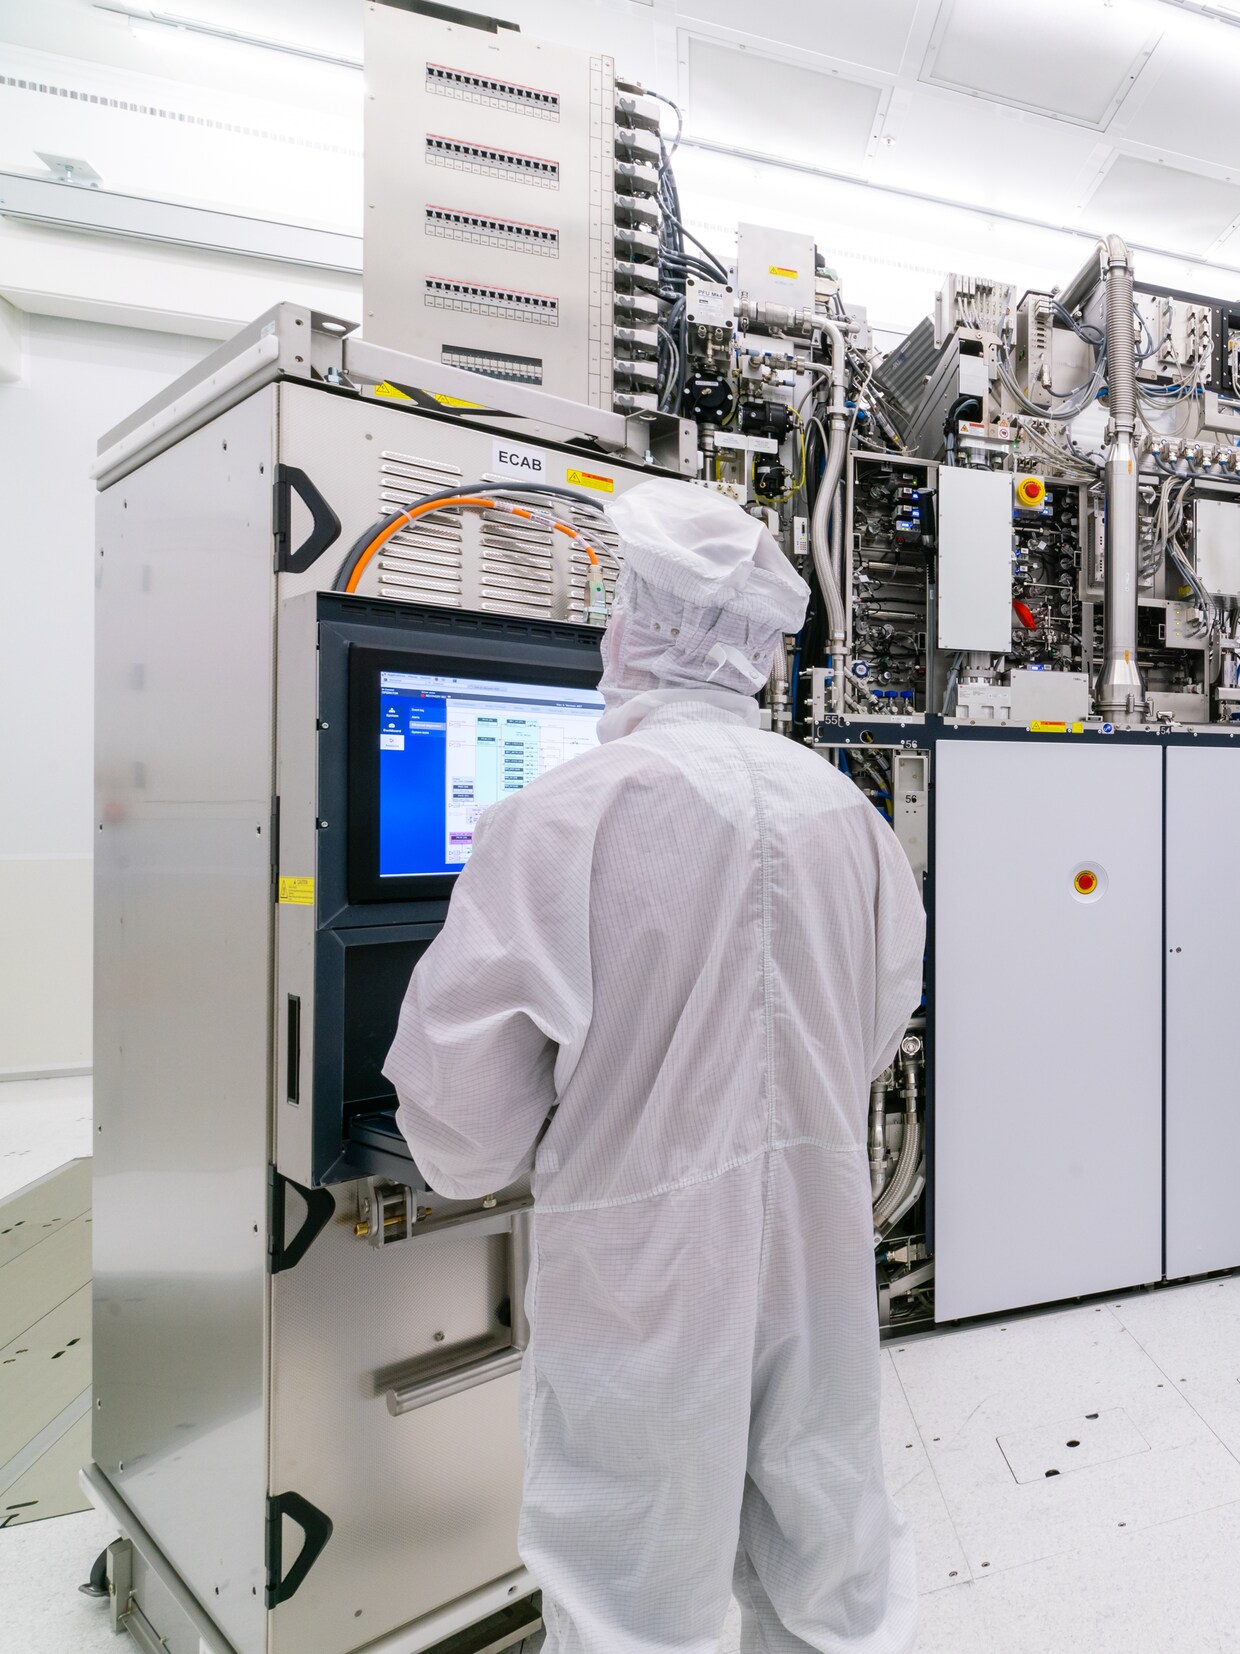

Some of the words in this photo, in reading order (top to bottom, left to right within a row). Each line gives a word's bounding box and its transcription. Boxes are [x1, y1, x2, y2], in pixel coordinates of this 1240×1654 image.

[498, 450, 543, 472] ECAB
[825, 716, 838, 725] 55
[1160, 726, 1171, 735] 54
[905, 740, 918, 749] 56
[905, 795, 917, 804] 56
